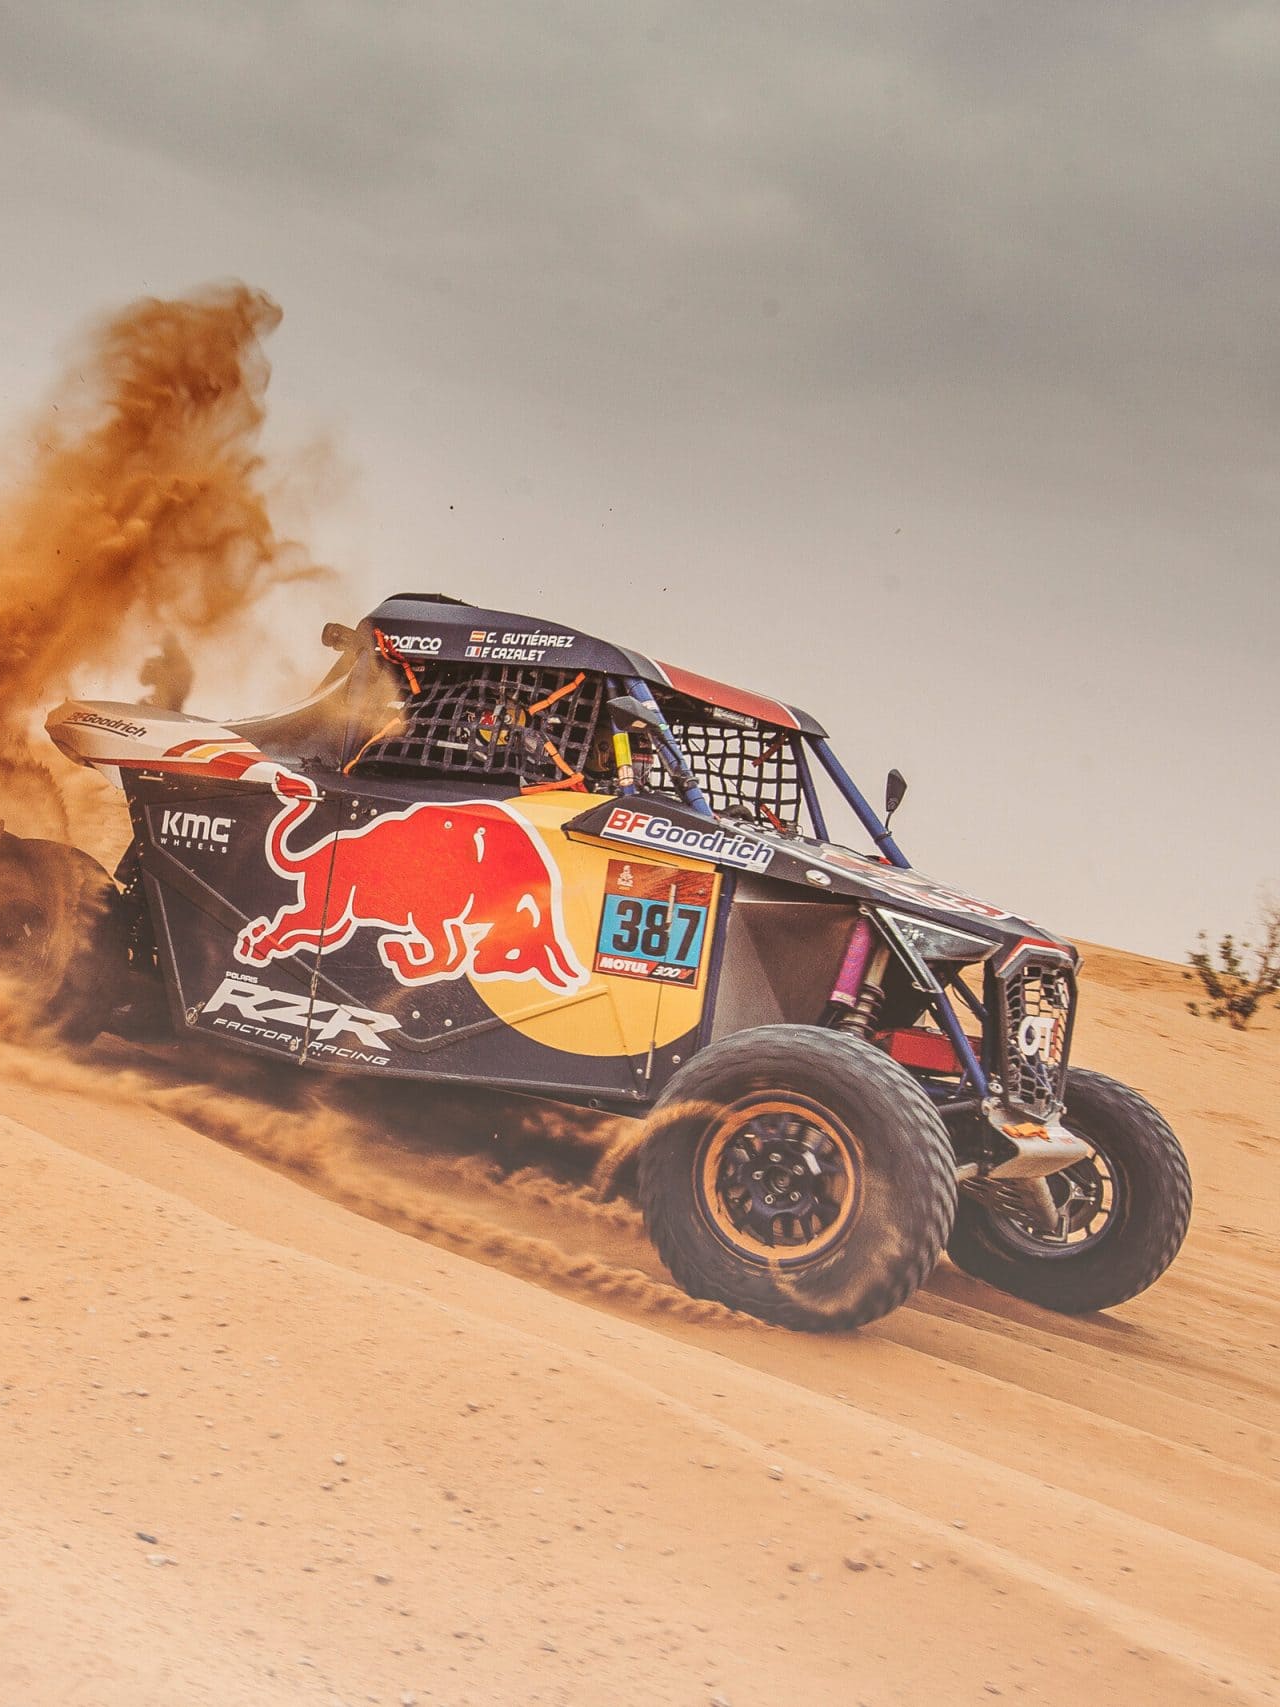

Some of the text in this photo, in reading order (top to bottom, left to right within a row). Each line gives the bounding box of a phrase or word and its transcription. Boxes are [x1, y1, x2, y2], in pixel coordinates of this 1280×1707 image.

[486, 629, 575, 648] C. GUTIÉRREZ
[491, 647, 546, 662] CAZALET
[161, 810, 231, 843] KMC
[607, 809, 771, 864] BFGoodrich
[160, 837, 228, 853] WHEELS
[612, 899, 702, 961] 387
[225, 970, 259, 984] POLARIS
[599, 956, 694, 980] MOTUL 300V
[202, 978, 403, 1052] RZR
[213, 1018, 391, 1066] FACTORY RACING
